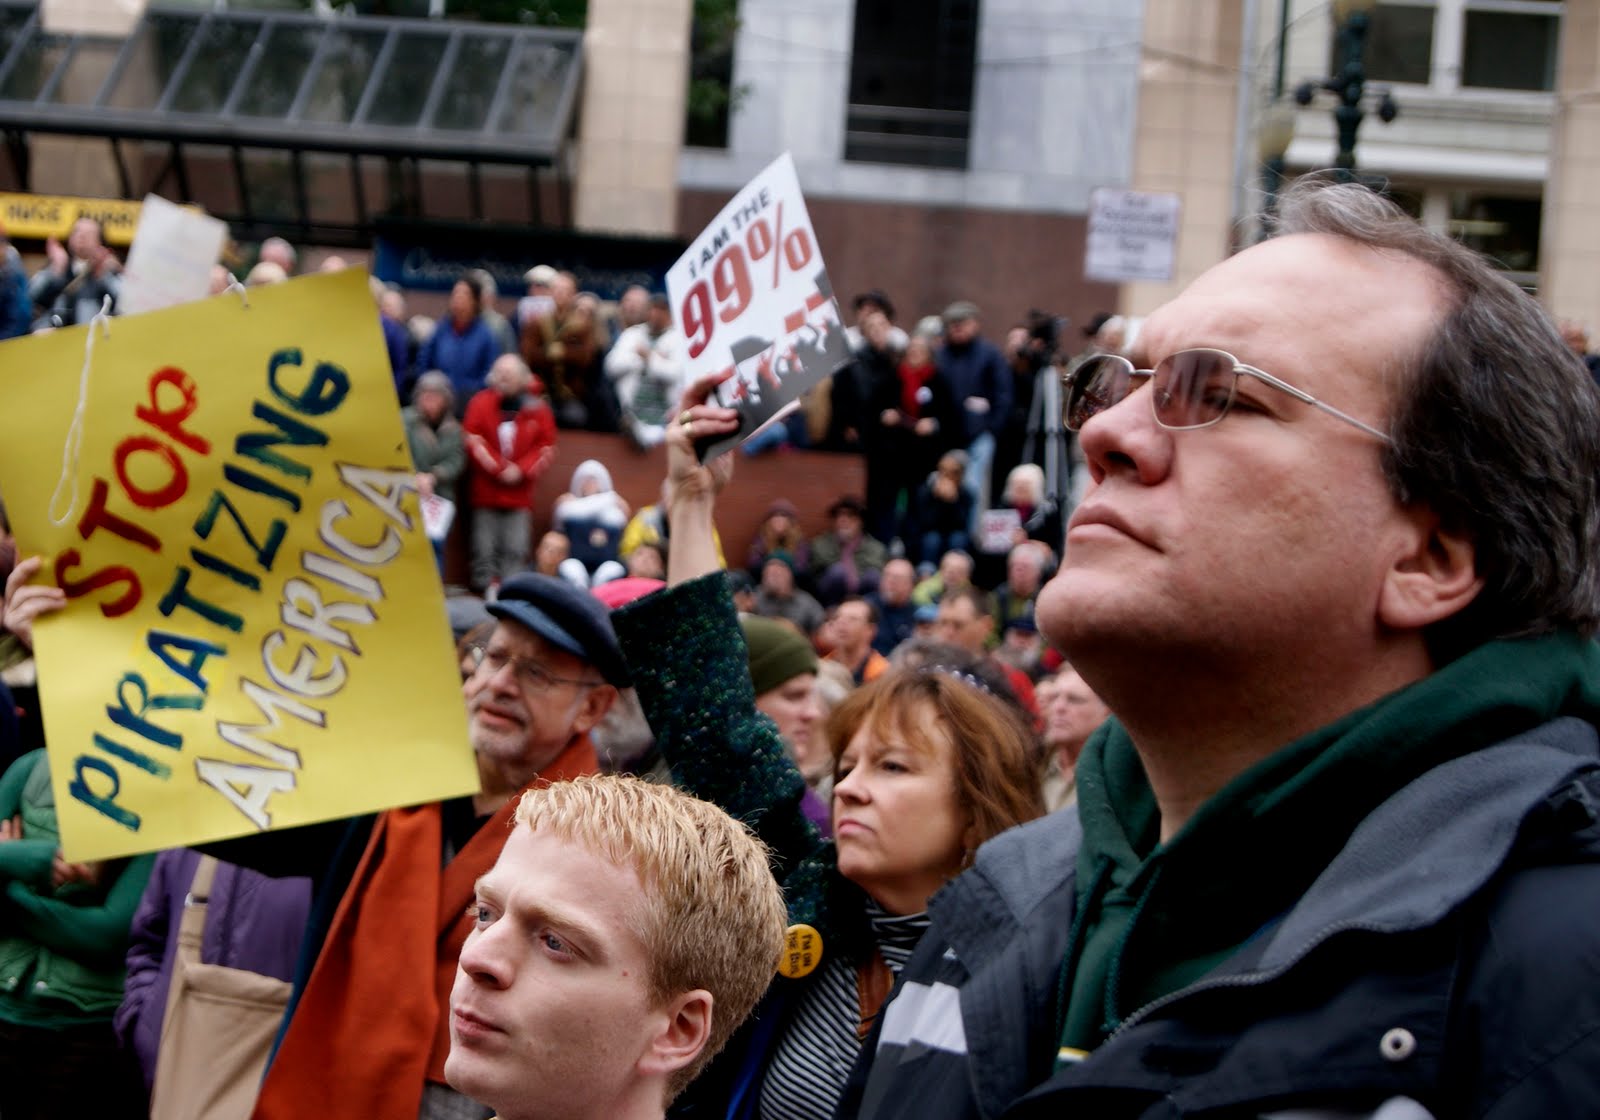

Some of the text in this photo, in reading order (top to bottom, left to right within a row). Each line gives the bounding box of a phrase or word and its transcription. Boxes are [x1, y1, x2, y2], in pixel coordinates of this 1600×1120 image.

[682, 202, 813, 359] 99%
[702, 226, 730, 267] AM
[732, 187, 769, 229] THE
[55, 366, 211, 618] STOP
[69, 347, 351, 832] PIRATIZING
[194, 460, 417, 830] AMERICA
